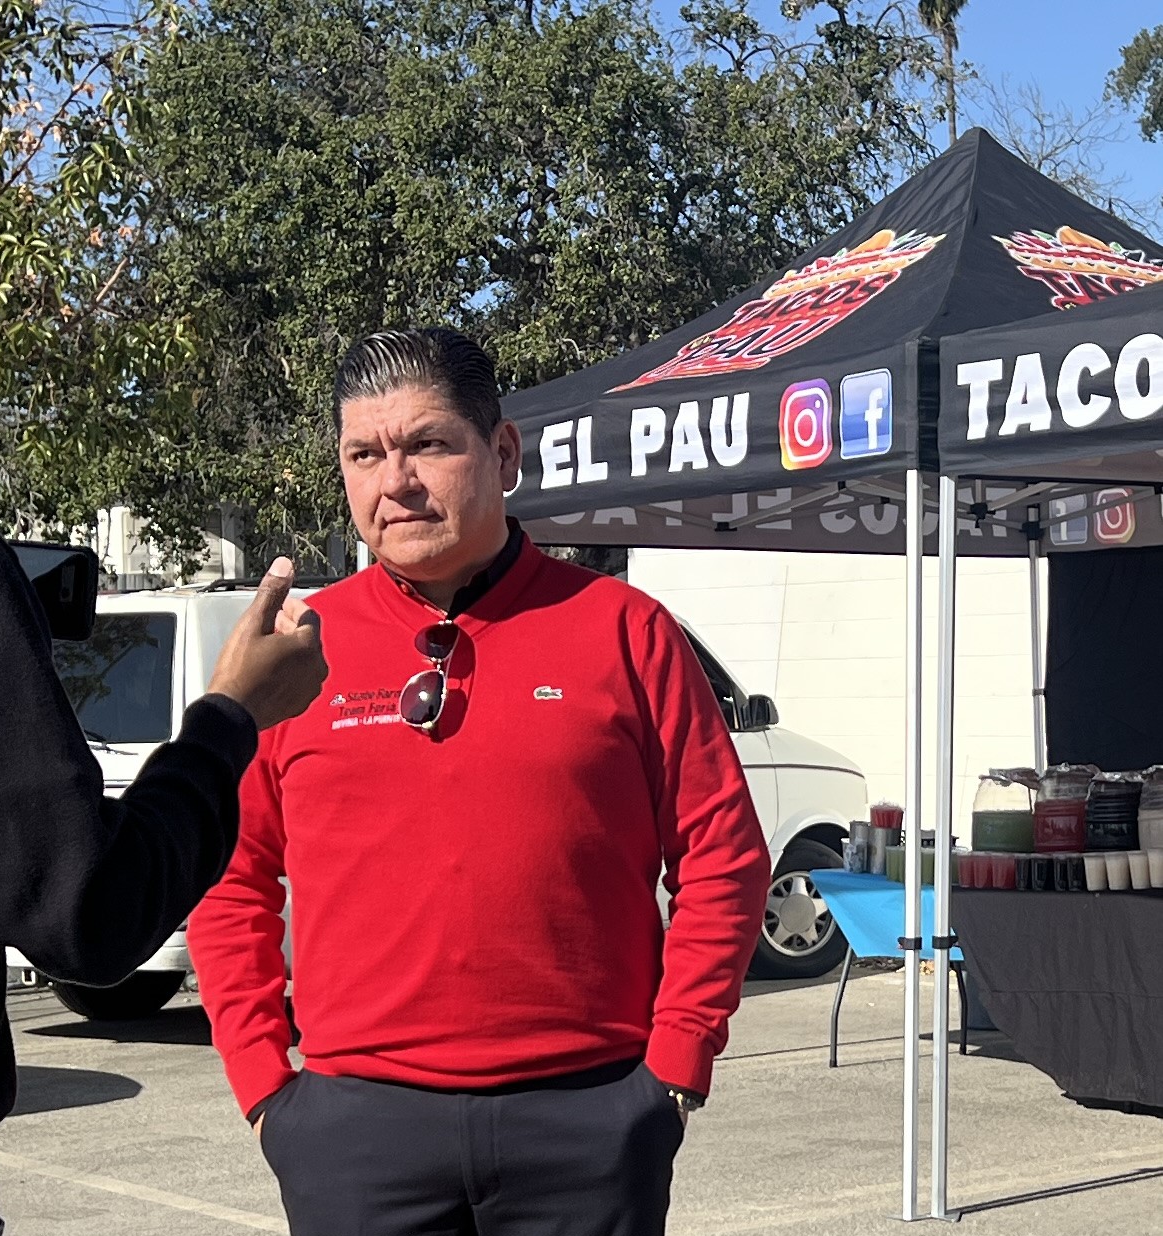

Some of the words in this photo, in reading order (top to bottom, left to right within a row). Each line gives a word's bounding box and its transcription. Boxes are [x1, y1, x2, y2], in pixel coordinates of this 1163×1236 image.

[734, 270, 900, 325] TACOS
[956, 333, 1163, 441] TACO
[539, 415, 609, 489] EL
[630, 392, 750, 477] PAU
